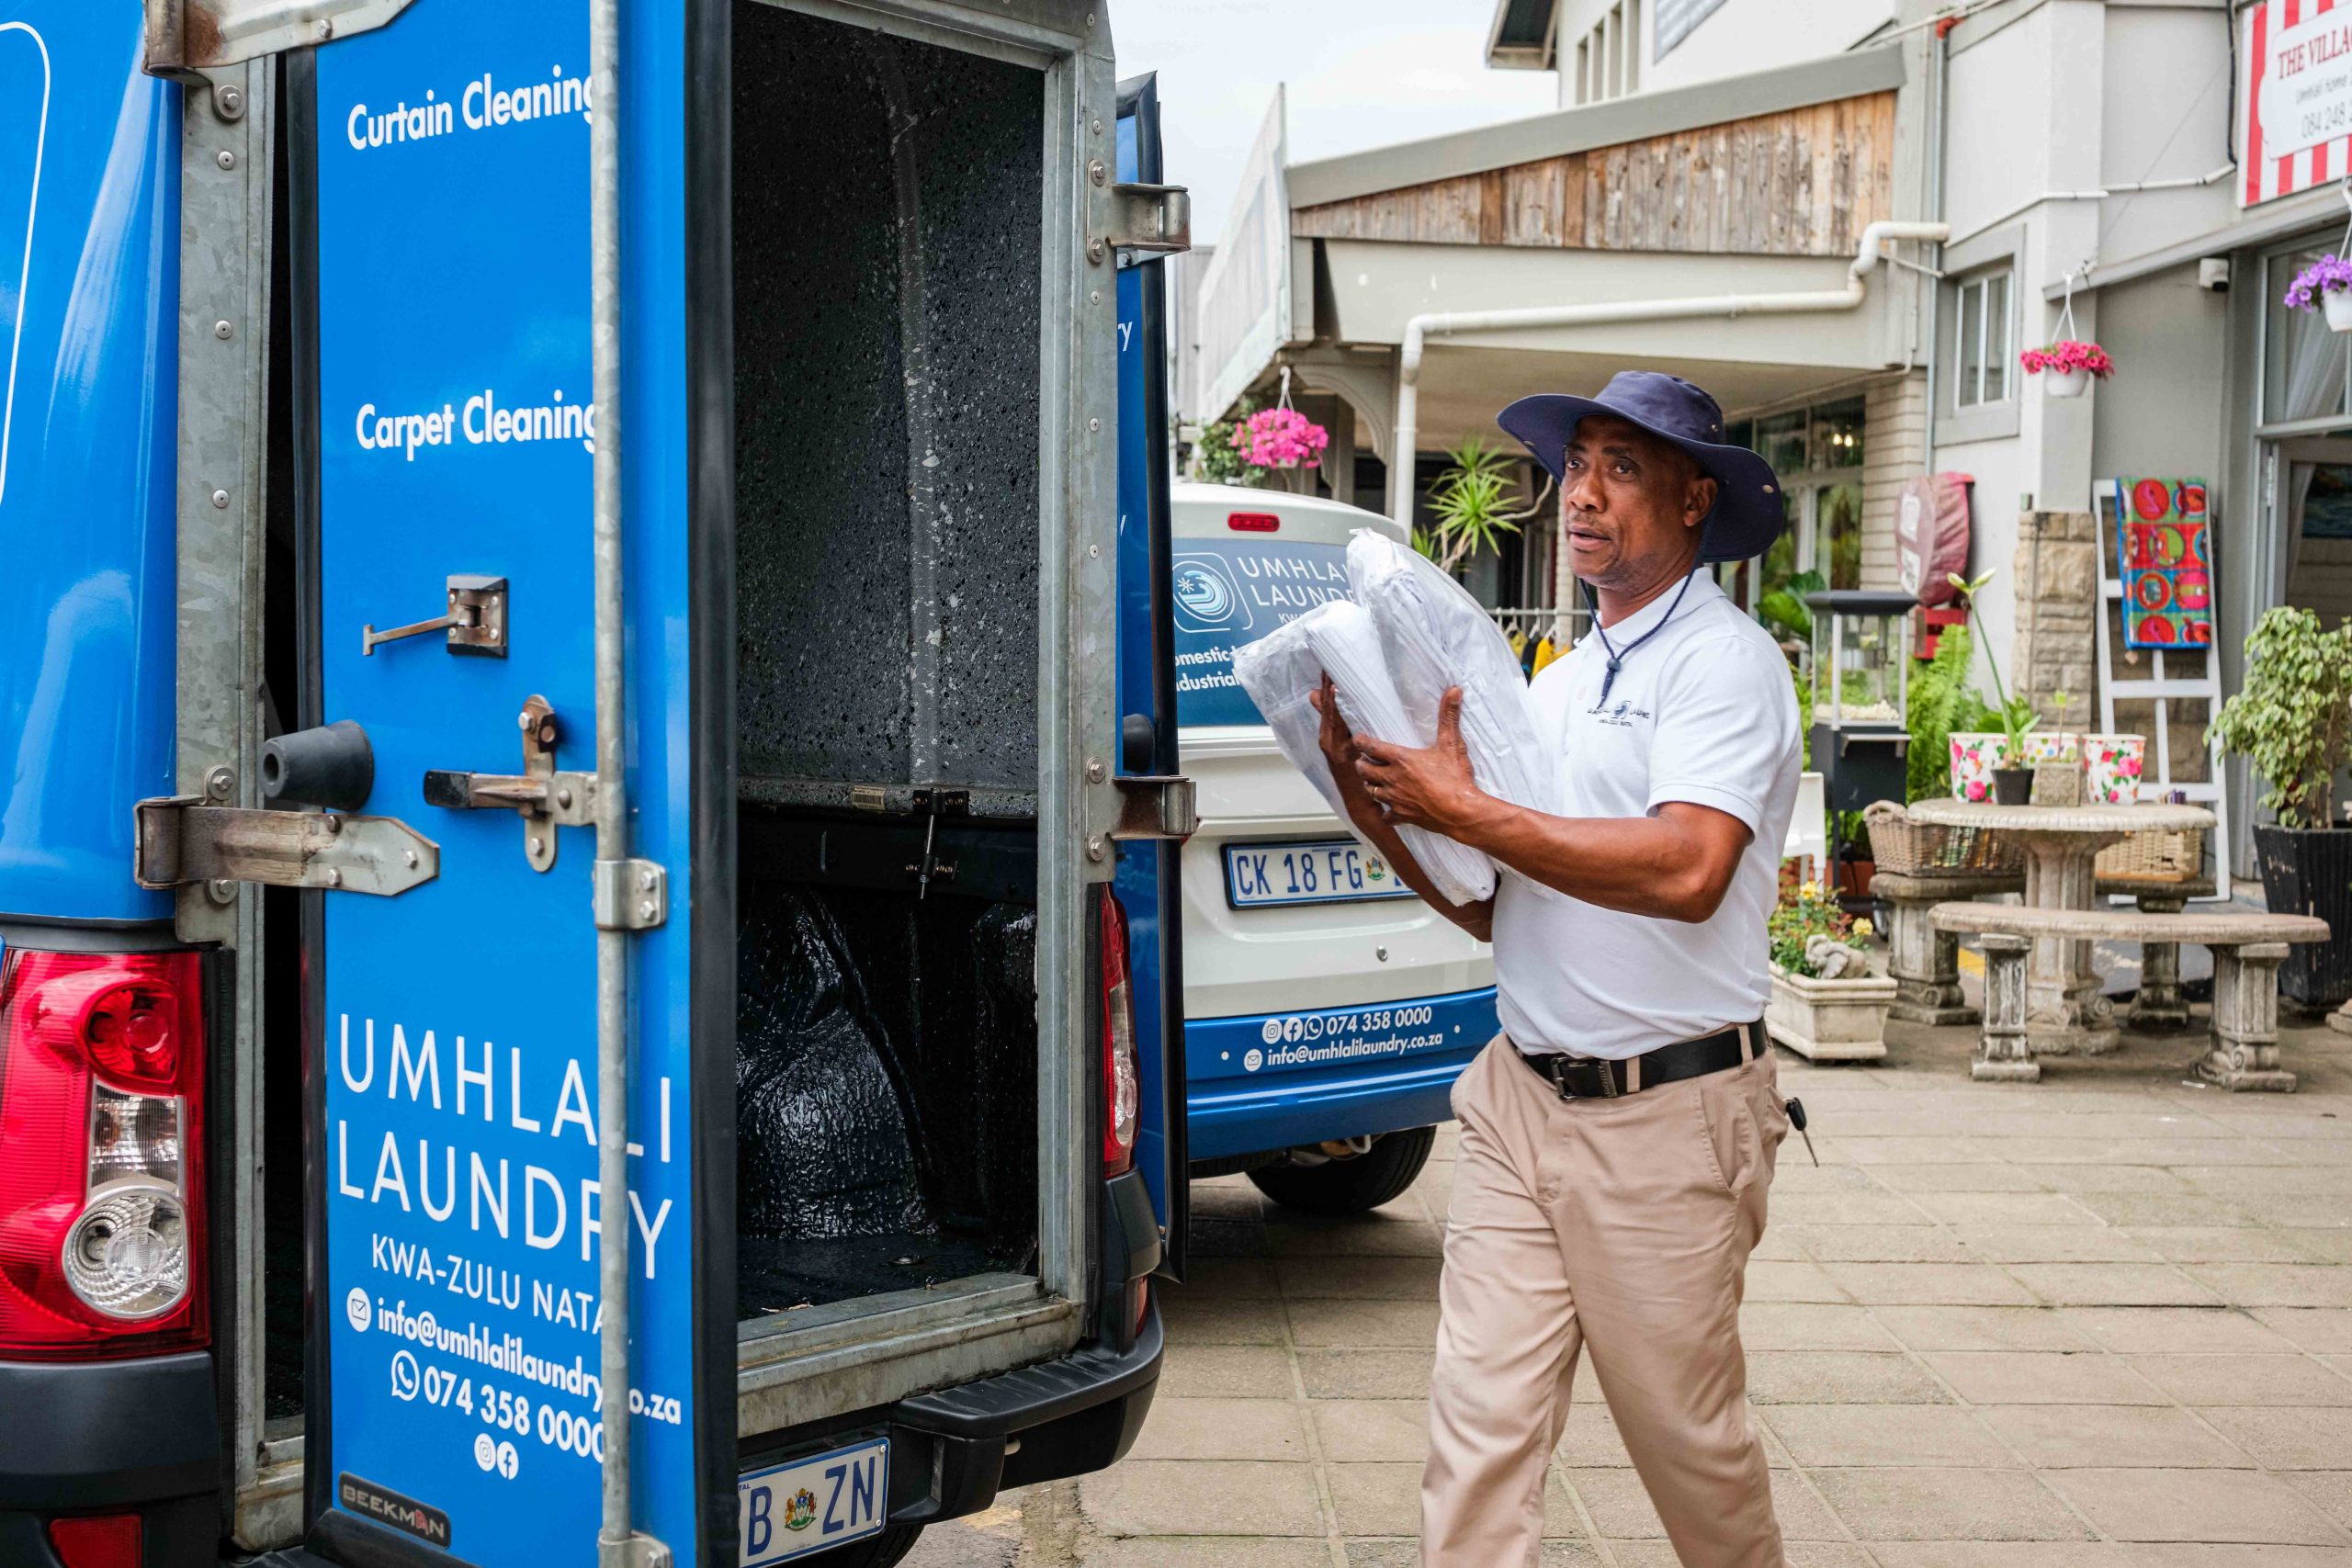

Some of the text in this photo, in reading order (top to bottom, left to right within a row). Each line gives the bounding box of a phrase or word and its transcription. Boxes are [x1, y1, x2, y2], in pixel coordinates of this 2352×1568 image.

[2278, 24, 2352, 80] THE VILLA
[347, 89, 453, 151] Curtain
[356, 403, 455, 462] Carpet
[1237, 851, 1363, 896] CK 18 FG
[1267, 1033, 1443, 1066] info@umhlalilaundry.co.za
[1327, 1006, 1432, 1035] 074 358 0000
[341, 1013, 671, 1163] UMHLAI
[372, 1233, 521, 1311] KWA-ZULU
[378, 1297, 682, 1425] info@umhlalilaundryo.za
[424, 1365, 604, 1464] 074 358 0000
[343, 1484, 445, 1539] BEEKMAN
[747, 1456, 876, 1557] B ZN
